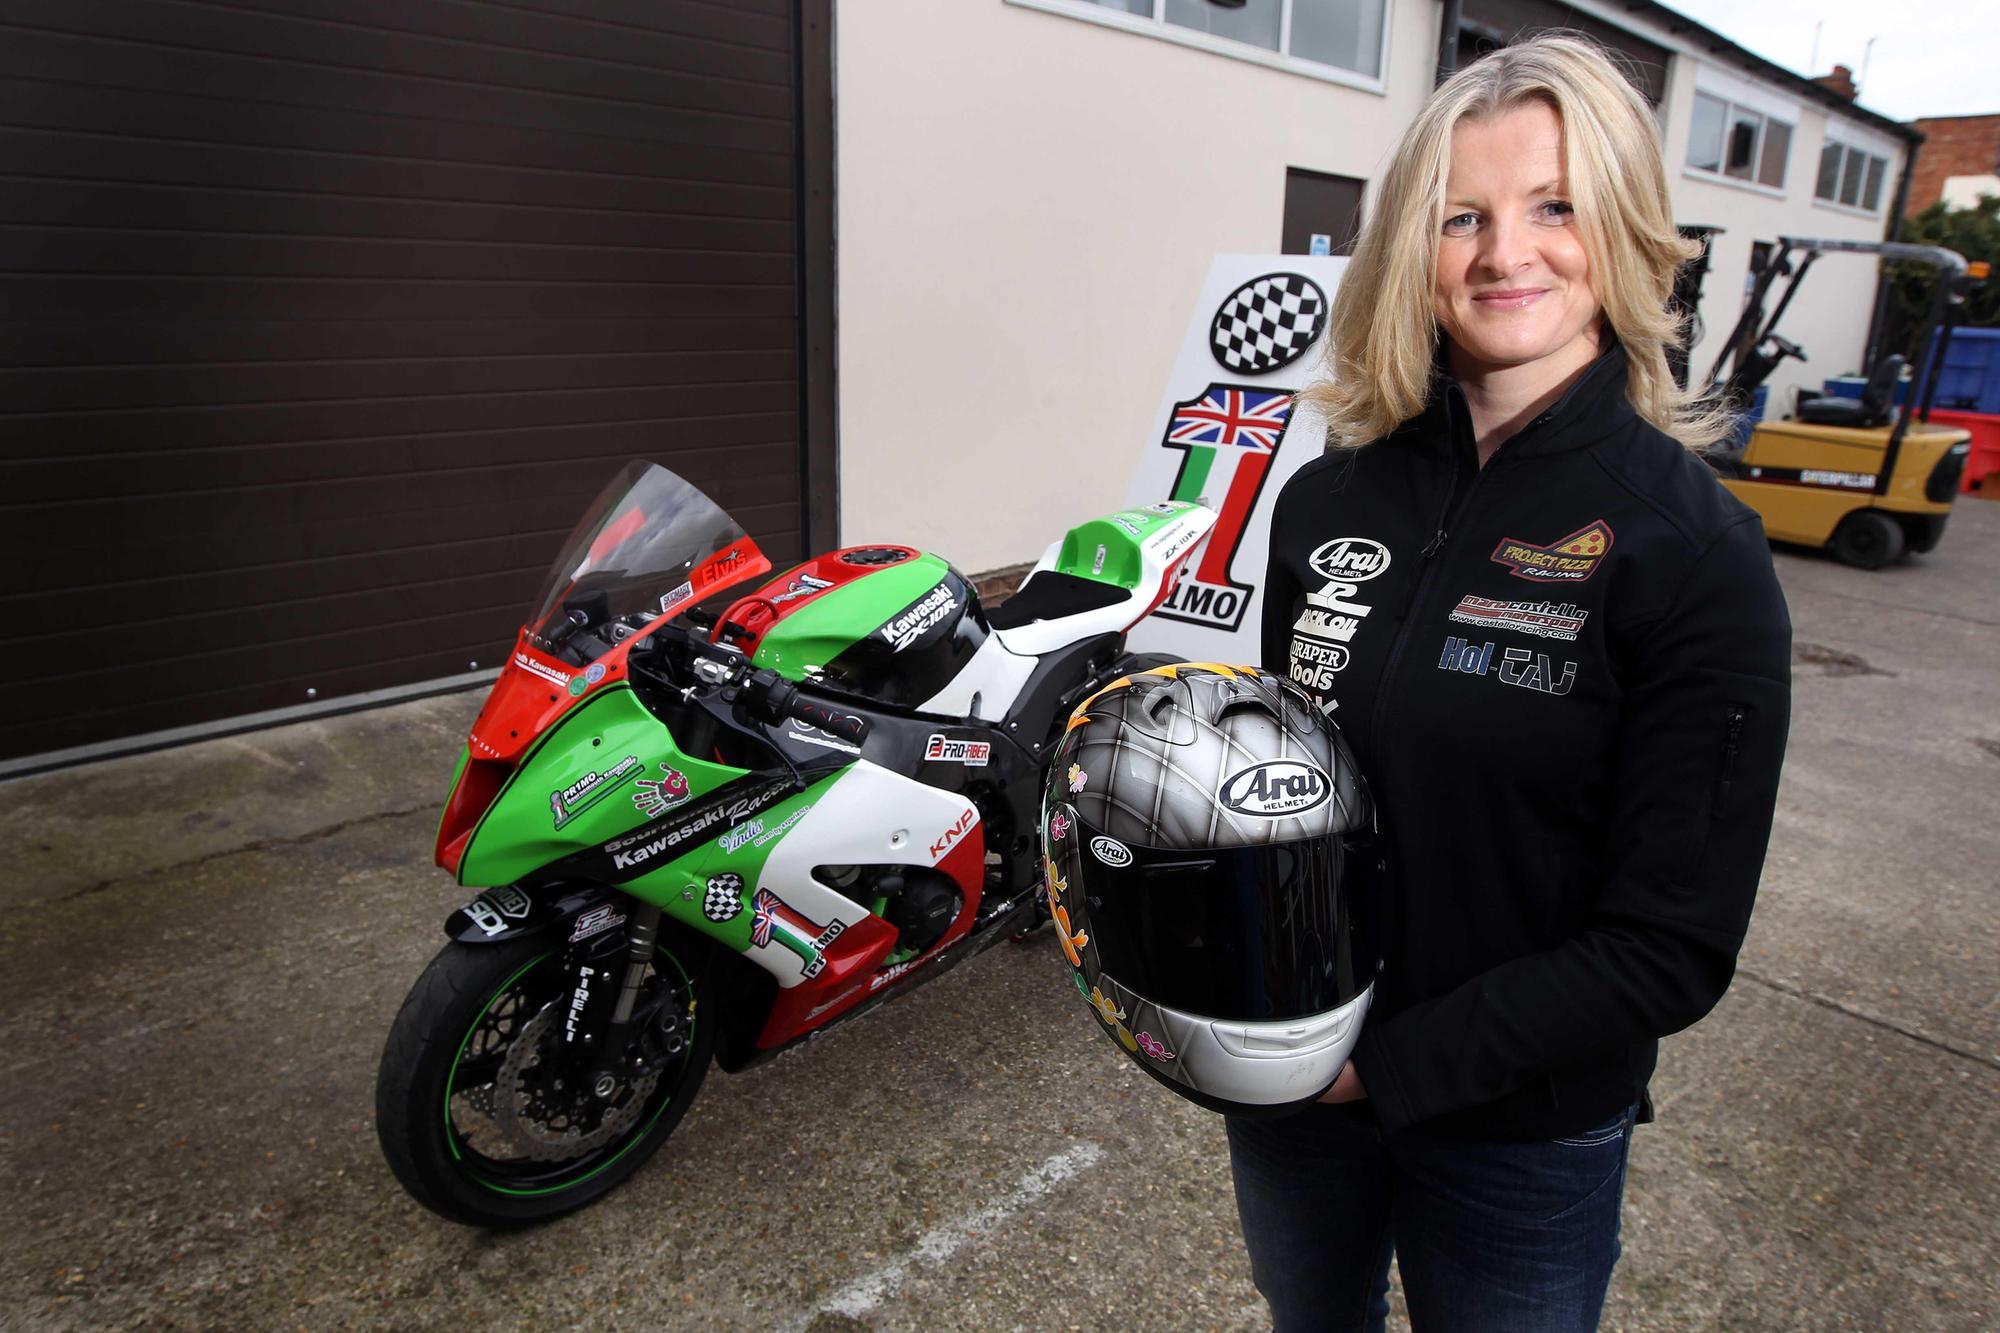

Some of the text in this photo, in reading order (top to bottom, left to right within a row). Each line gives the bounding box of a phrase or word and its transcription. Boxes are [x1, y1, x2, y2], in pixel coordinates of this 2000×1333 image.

[702, 552, 747, 586] Elvis
[1311, 541, 1384, 572] Arai
[1328, 567, 1361, 577] HELMET
[1502, 545, 1595, 571] PROJECT PIZZA
[1523, 567, 1585, 578] RACING
[880, 583, 953, 643] Kawasaki
[893, 599, 958, 653] ZX-10R
[1449, 613, 1578, 641] www.costelloracing.com
[1500, 611, 1584, 633] motorsport
[1292, 640, 1340, 667] DRAPER
[528, 658, 570, 682] Kawasaki
[1290, 656, 1334, 690] Tools
[1230, 767, 1320, 807] Arai
[1264, 799, 1305, 810] HELMET
[613, 805, 726, 870] Kawasaki
[719, 819, 764, 855] Vindis
[754, 830, 775, 847] Driven
[781, 805, 810, 830] experience
[929, 808, 974, 858] KNP
[1094, 841, 1127, 860] Arai
[566, 966, 594, 1042] PIRELLI
